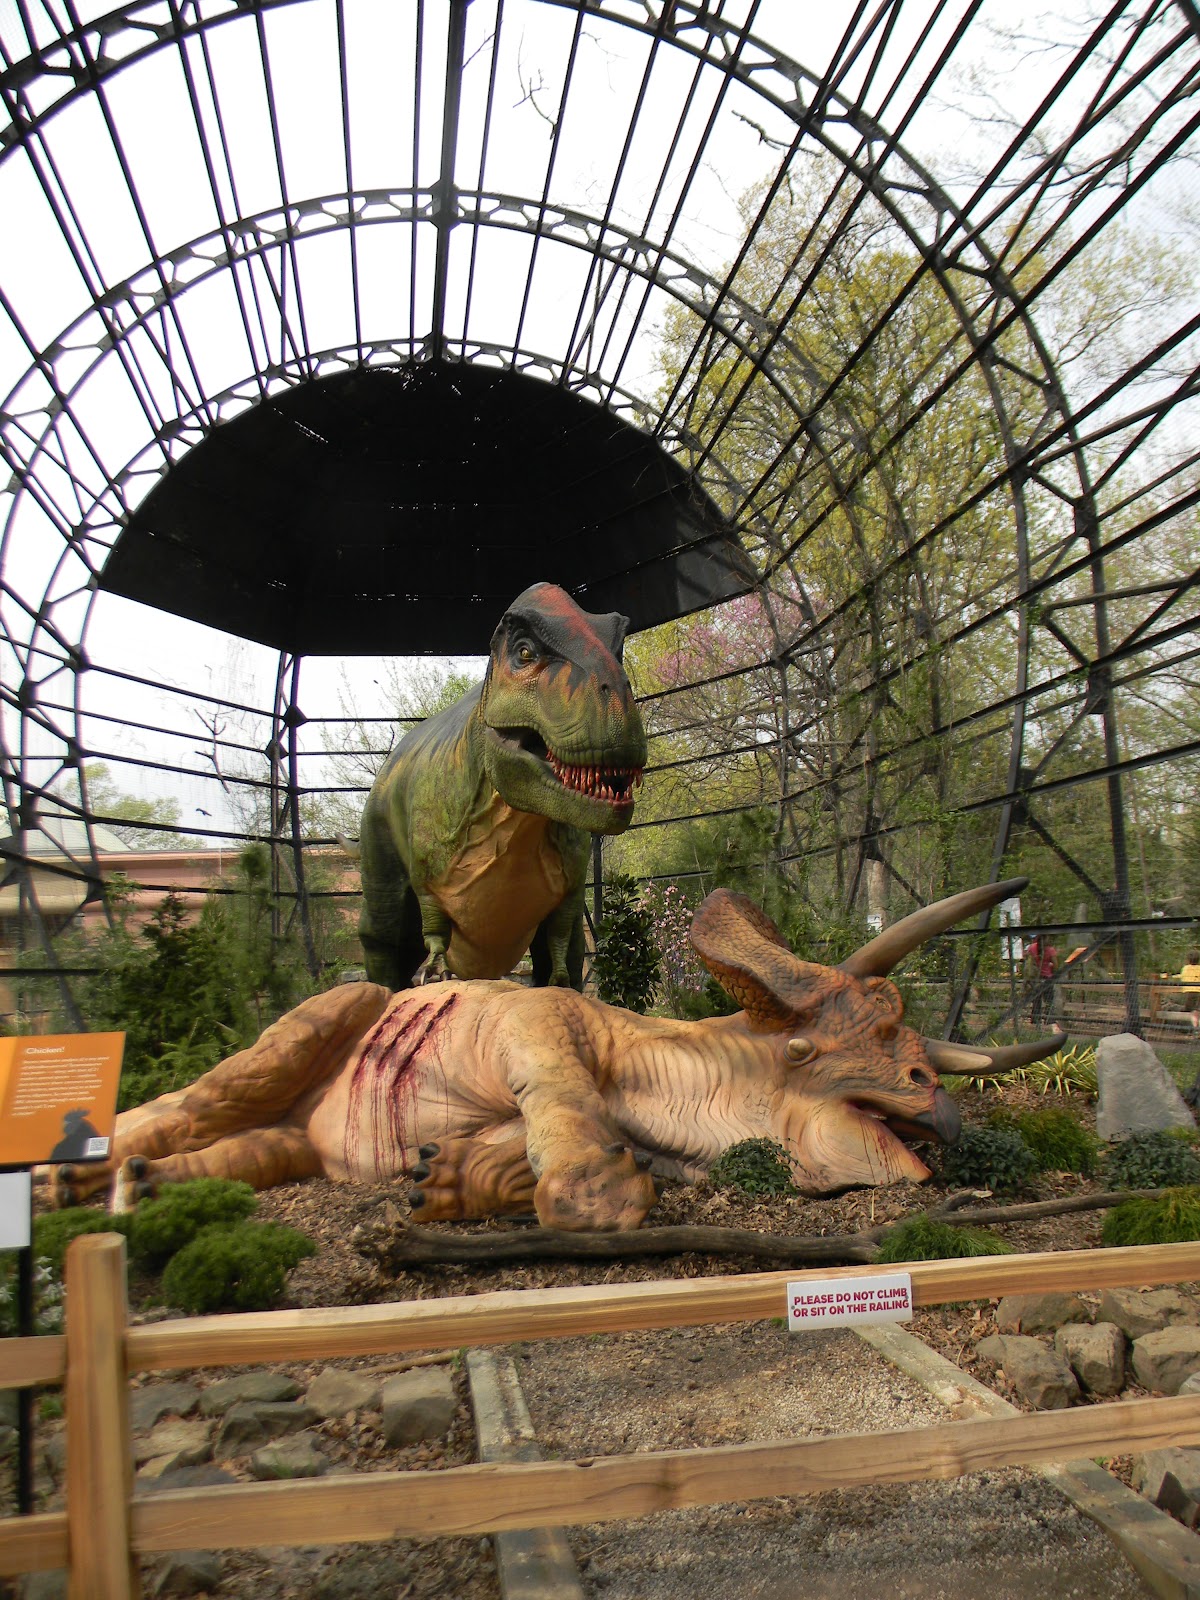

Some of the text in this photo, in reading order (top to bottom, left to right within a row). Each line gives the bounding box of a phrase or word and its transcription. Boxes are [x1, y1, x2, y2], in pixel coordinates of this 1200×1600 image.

[794, 1287, 907, 1305] PLEASE DO NOT CLIMB
[793, 1299, 909, 1318] OR SIT ON THE RAILING
